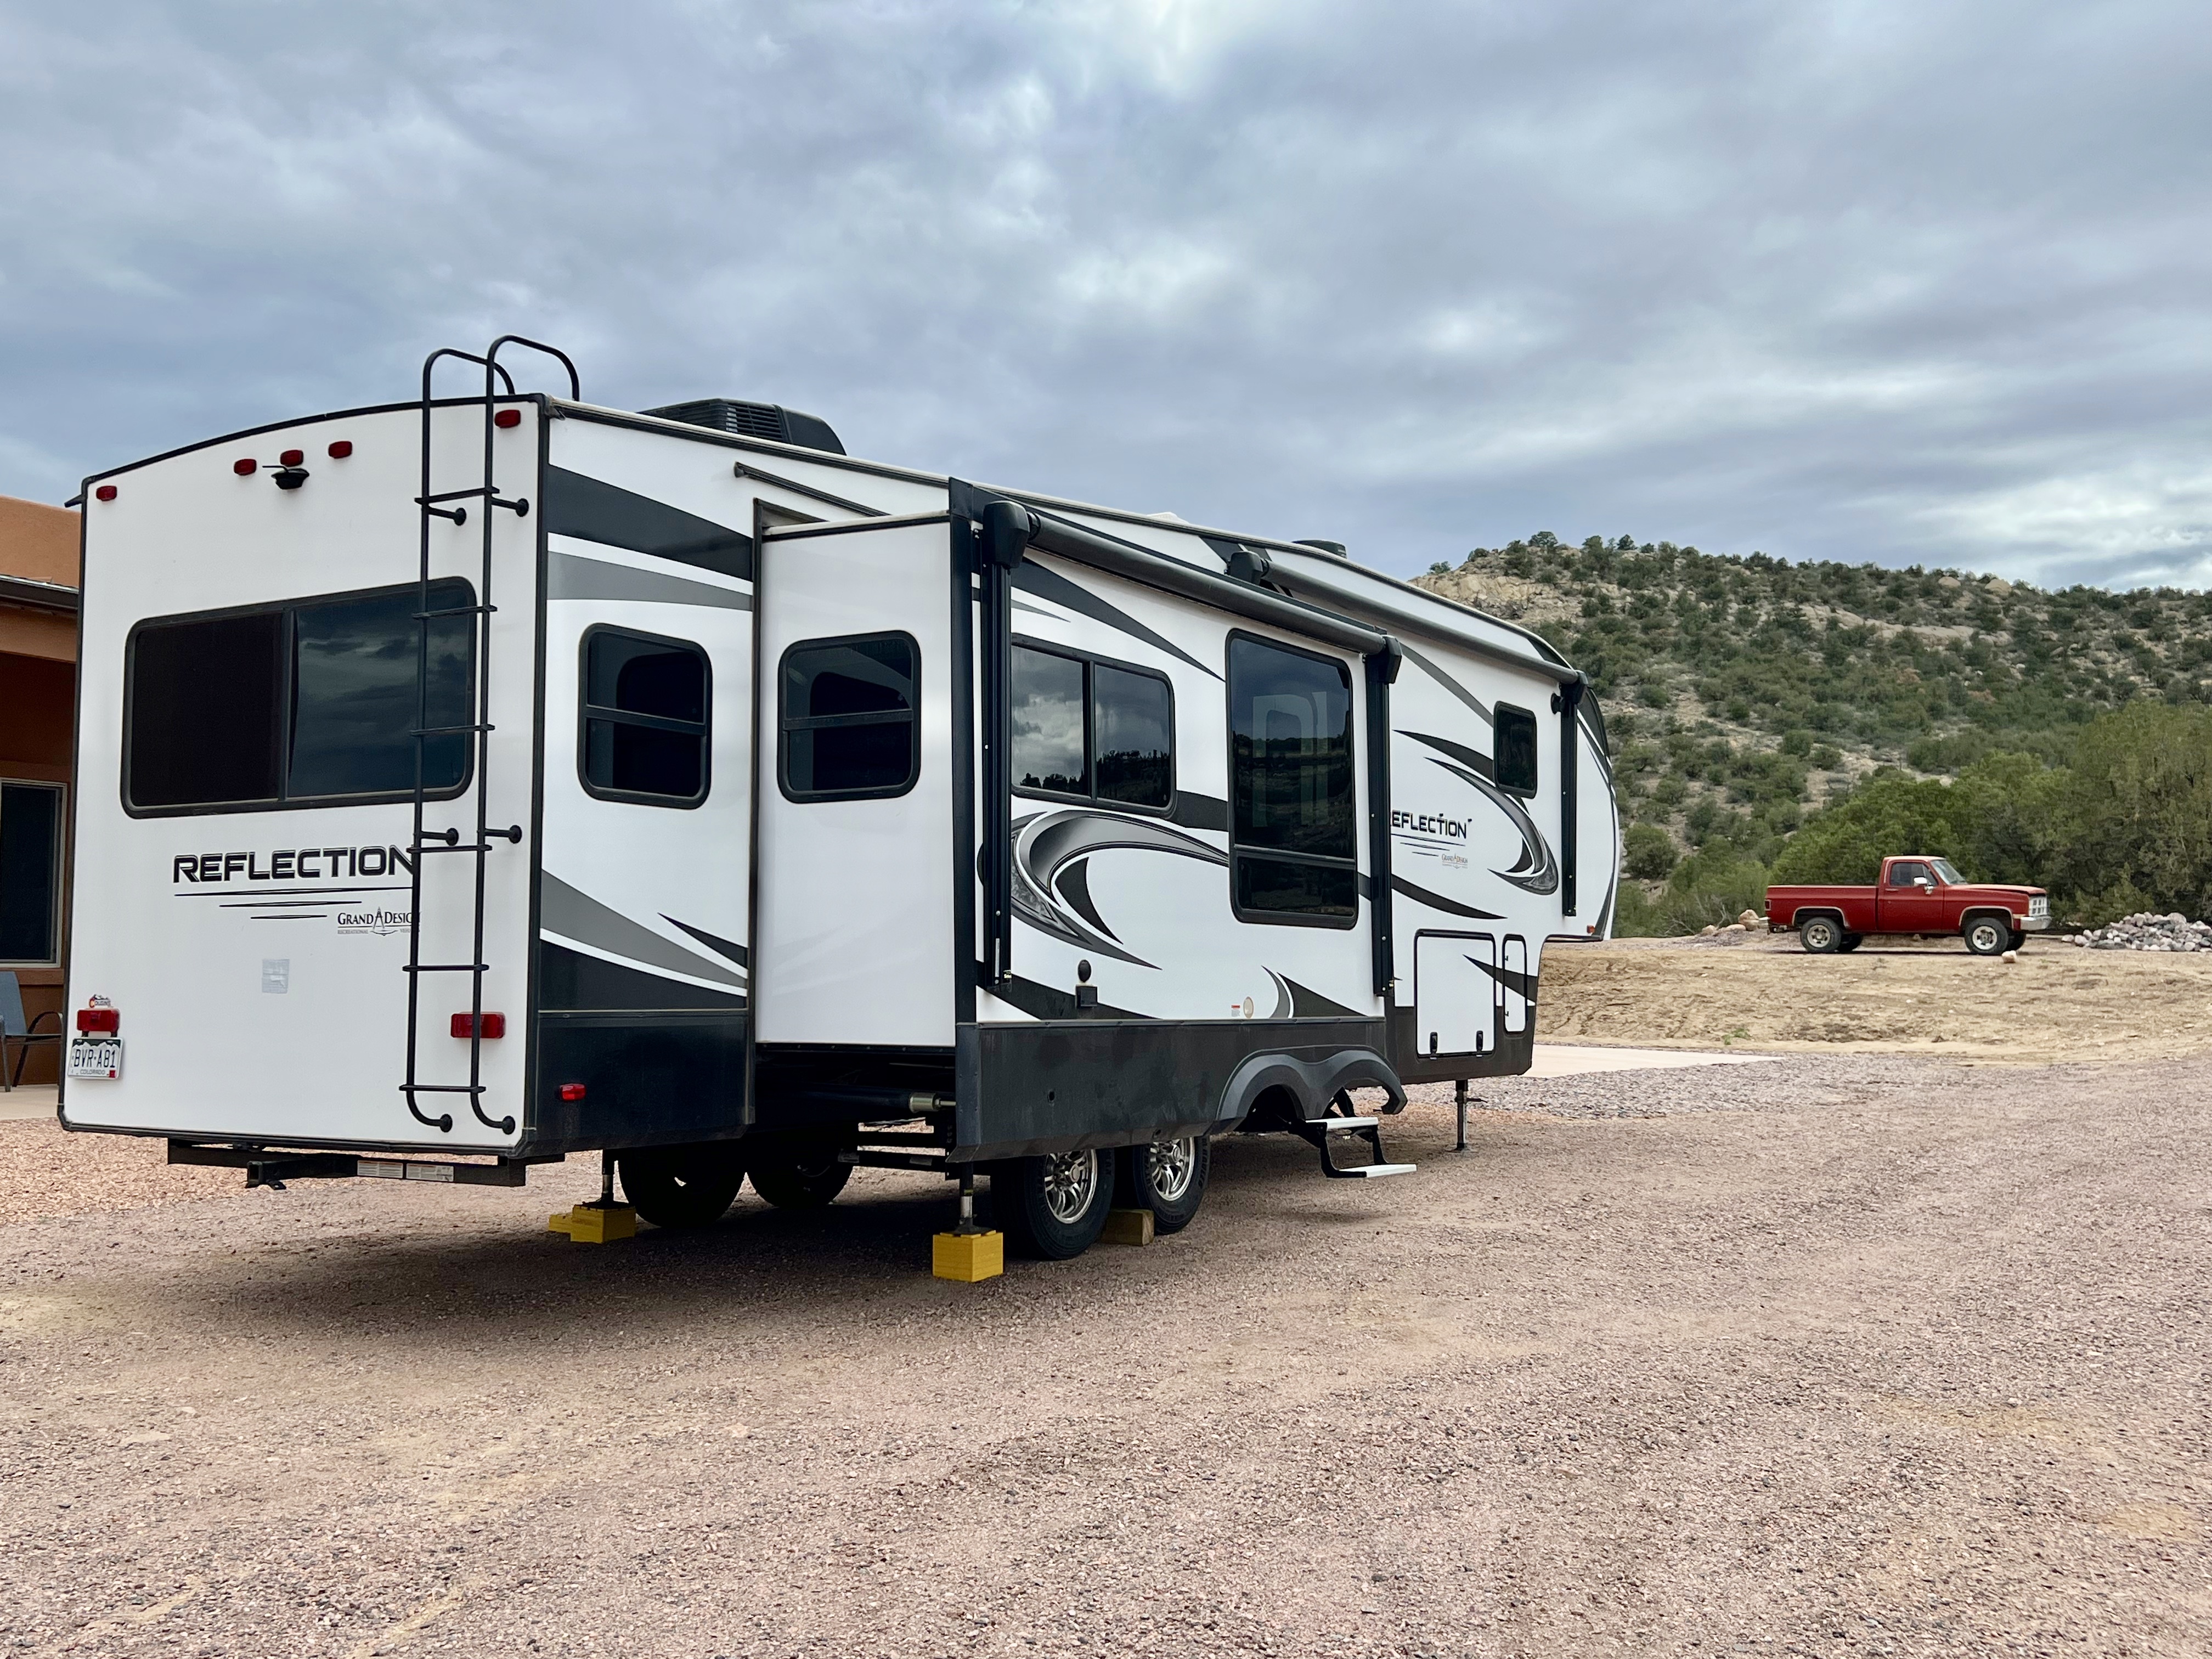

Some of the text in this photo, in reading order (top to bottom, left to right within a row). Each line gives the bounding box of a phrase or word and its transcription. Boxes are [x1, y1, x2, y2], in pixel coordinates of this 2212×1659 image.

[1390, 809, 1466, 839] EFLECTION
[173, 845, 413, 883] REFLECTION
[337, 911, 420, 925] GRAND DESIG
